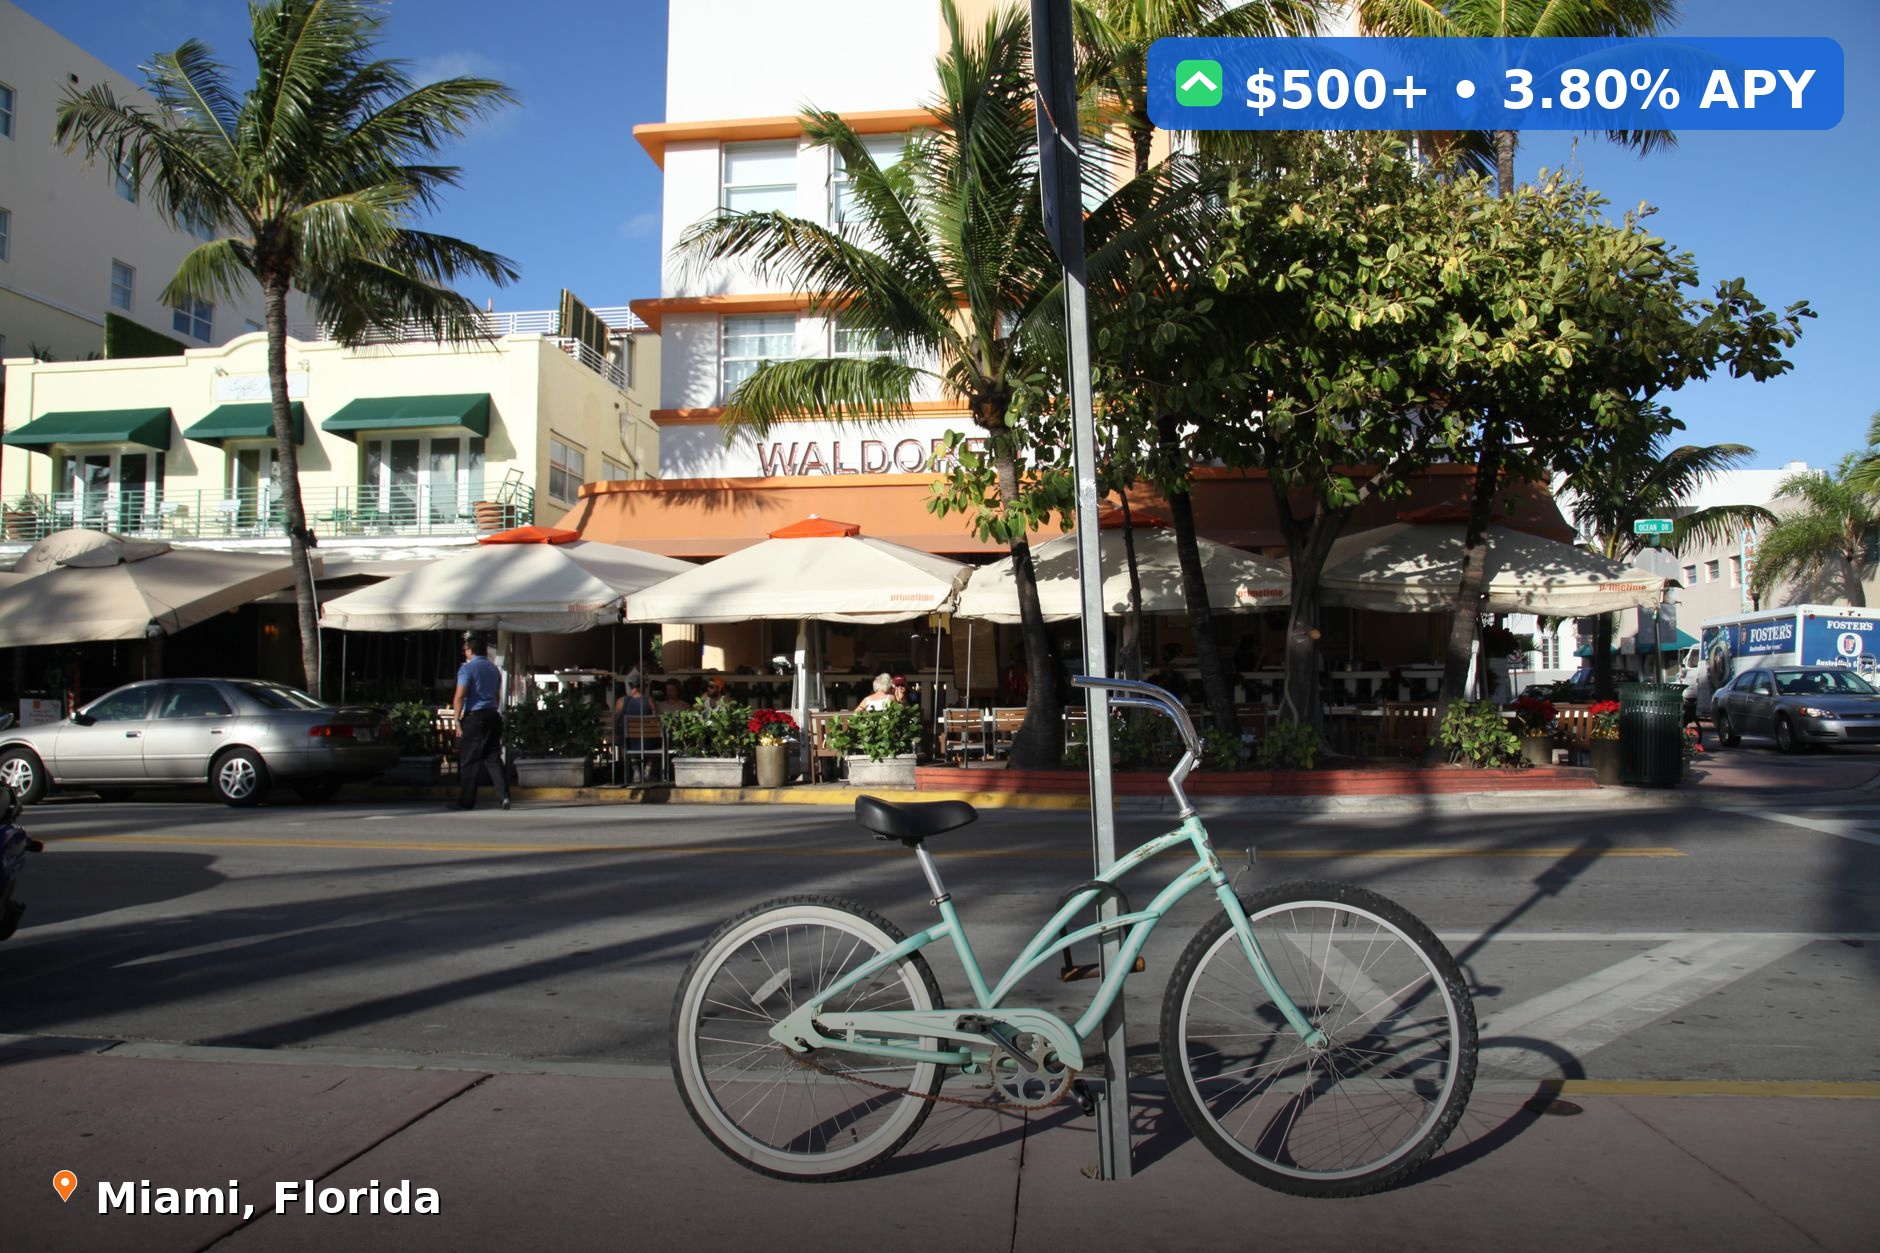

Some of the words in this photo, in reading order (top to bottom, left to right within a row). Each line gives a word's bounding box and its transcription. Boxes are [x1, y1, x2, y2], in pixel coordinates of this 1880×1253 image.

[1638, 523, 1657, 532] OCEAN
[1826, 620, 1873, 631] FOSTER'S
[1749, 623, 1793, 643] FOSTER'S
